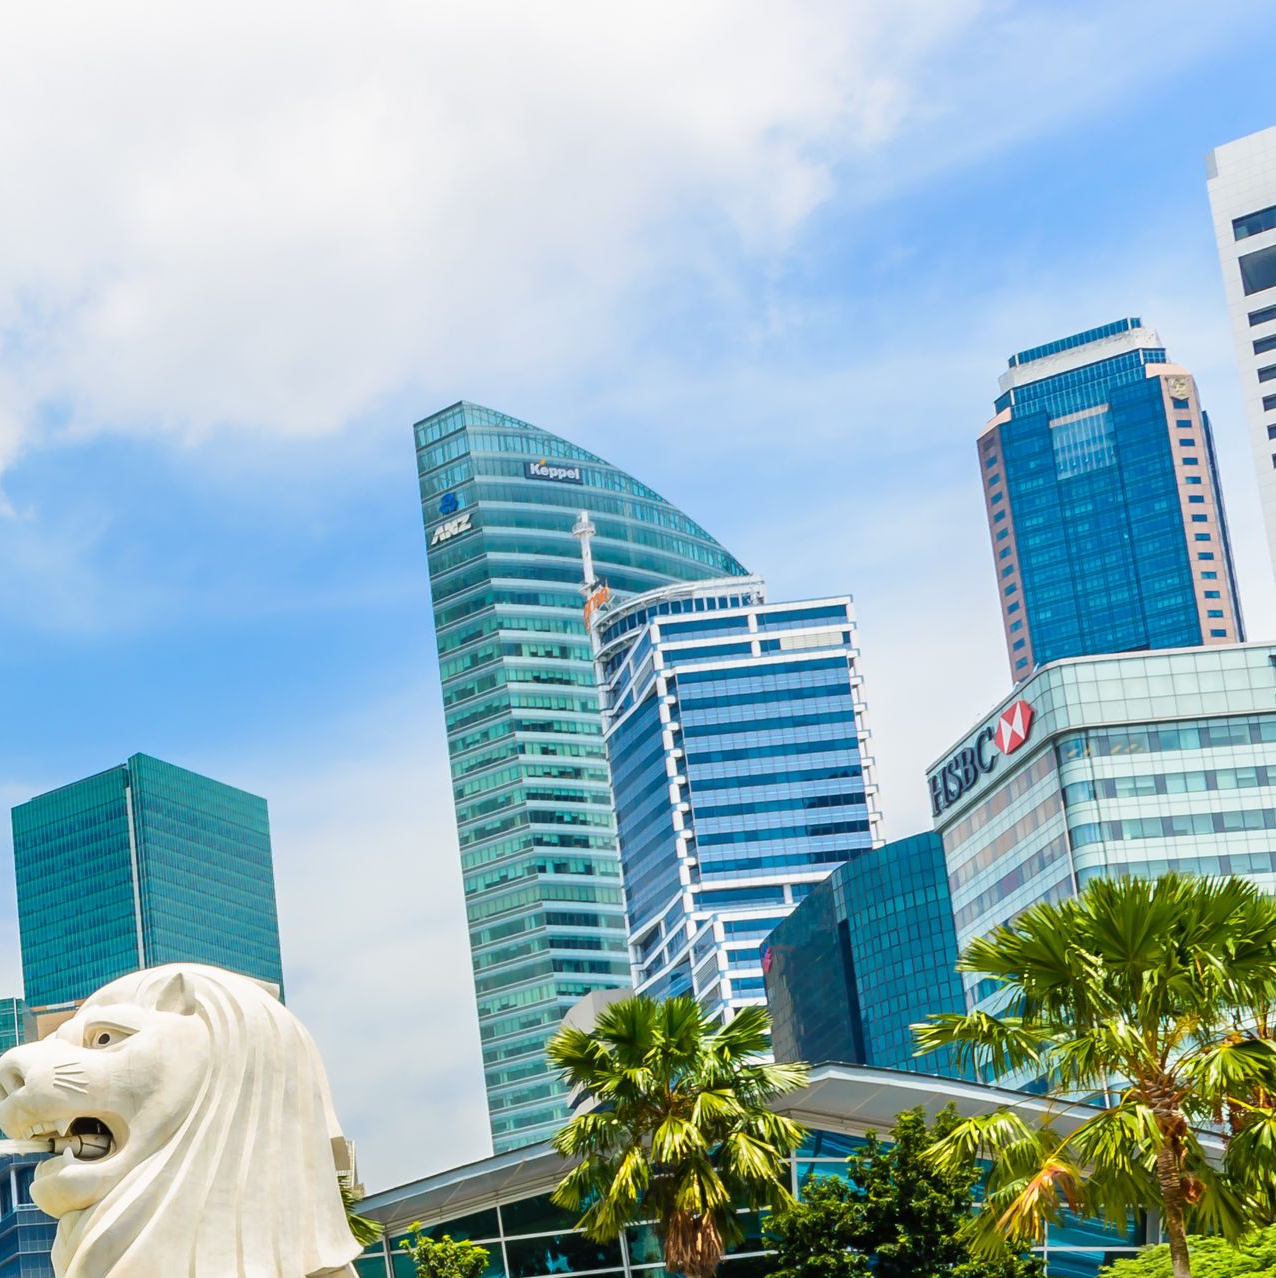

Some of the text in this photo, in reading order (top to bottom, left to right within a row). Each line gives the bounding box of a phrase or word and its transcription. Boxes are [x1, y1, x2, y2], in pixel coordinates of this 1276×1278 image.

[530, 463, 580, 480] Keppel
[430, 513, 473, 546] ANZ
[927, 726, 1001, 818] HSBC
